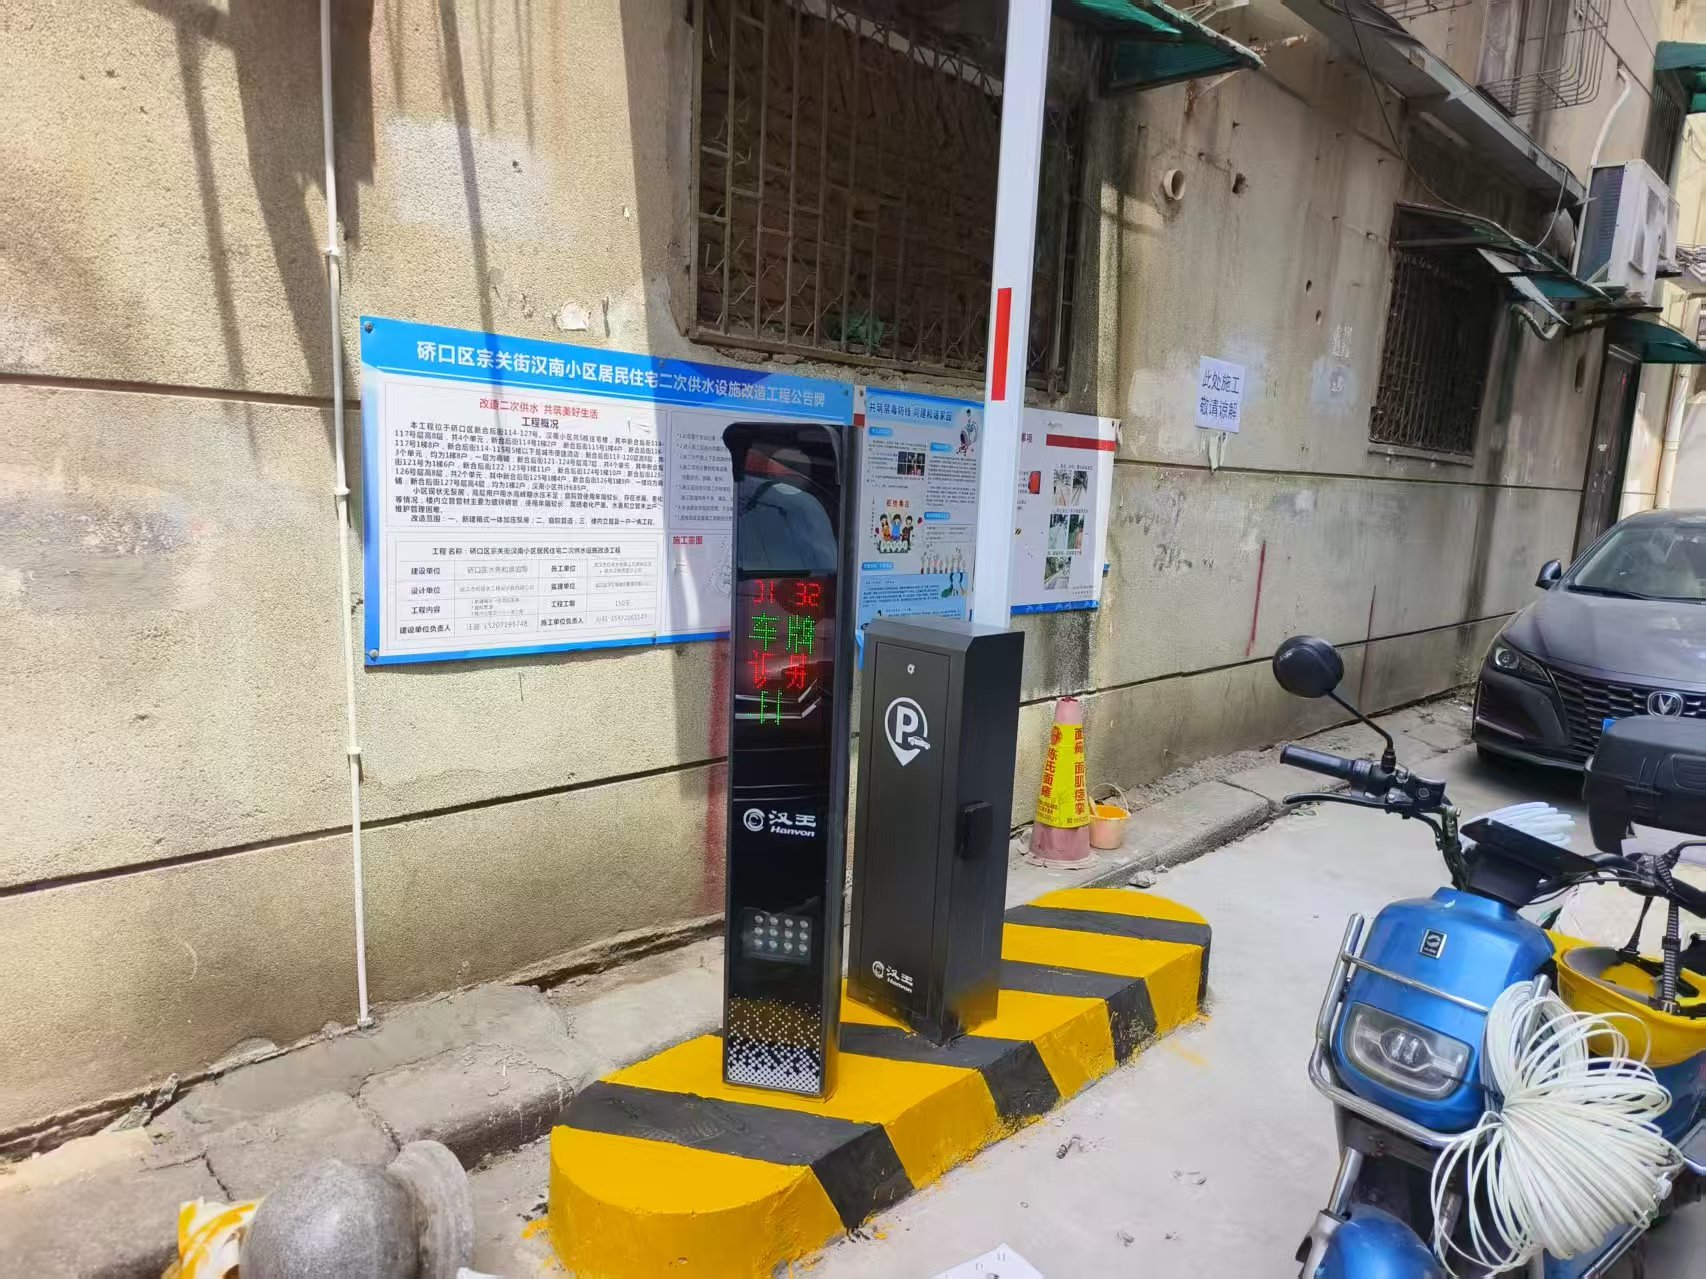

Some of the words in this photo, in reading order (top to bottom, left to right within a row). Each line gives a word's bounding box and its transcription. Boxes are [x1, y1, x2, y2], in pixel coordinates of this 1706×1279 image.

[417, 341, 825, 407] 硚口区宗关街汉南小区居民住宅二次供水设施改造工程公告牌
[1202, 369, 1240, 394] 此处施工
[480, 398, 538, 414] 改造二次供水
[543, 405, 598, 419] 共筑美好生活
[1200, 396, 1238, 421] 敬请谅解
[522, 416, 558, 429] 工程概况
[411, 566, 440, 575] 建设单位
[551, 564, 575, 572] 施工单位
[411, 586, 440, 595] 设计单位
[551, 582, 574, 590] 监理单位
[411, 605, 440, 614] 工程内容
[551, 600, 574, 608] 工程工期
[399, 623, 450, 635] 建设单位负责人
[540, 616, 583, 626] 施工单位负责人
[749, 612, 816, 655] 车牌
[895, 705, 919, 744] P
[769, 810, 817, 827] 汉王
[770, 826, 816, 838] Hanvon
[886, 965, 914, 987] 汉王
[886, 977, 913, 993] Hanvon
